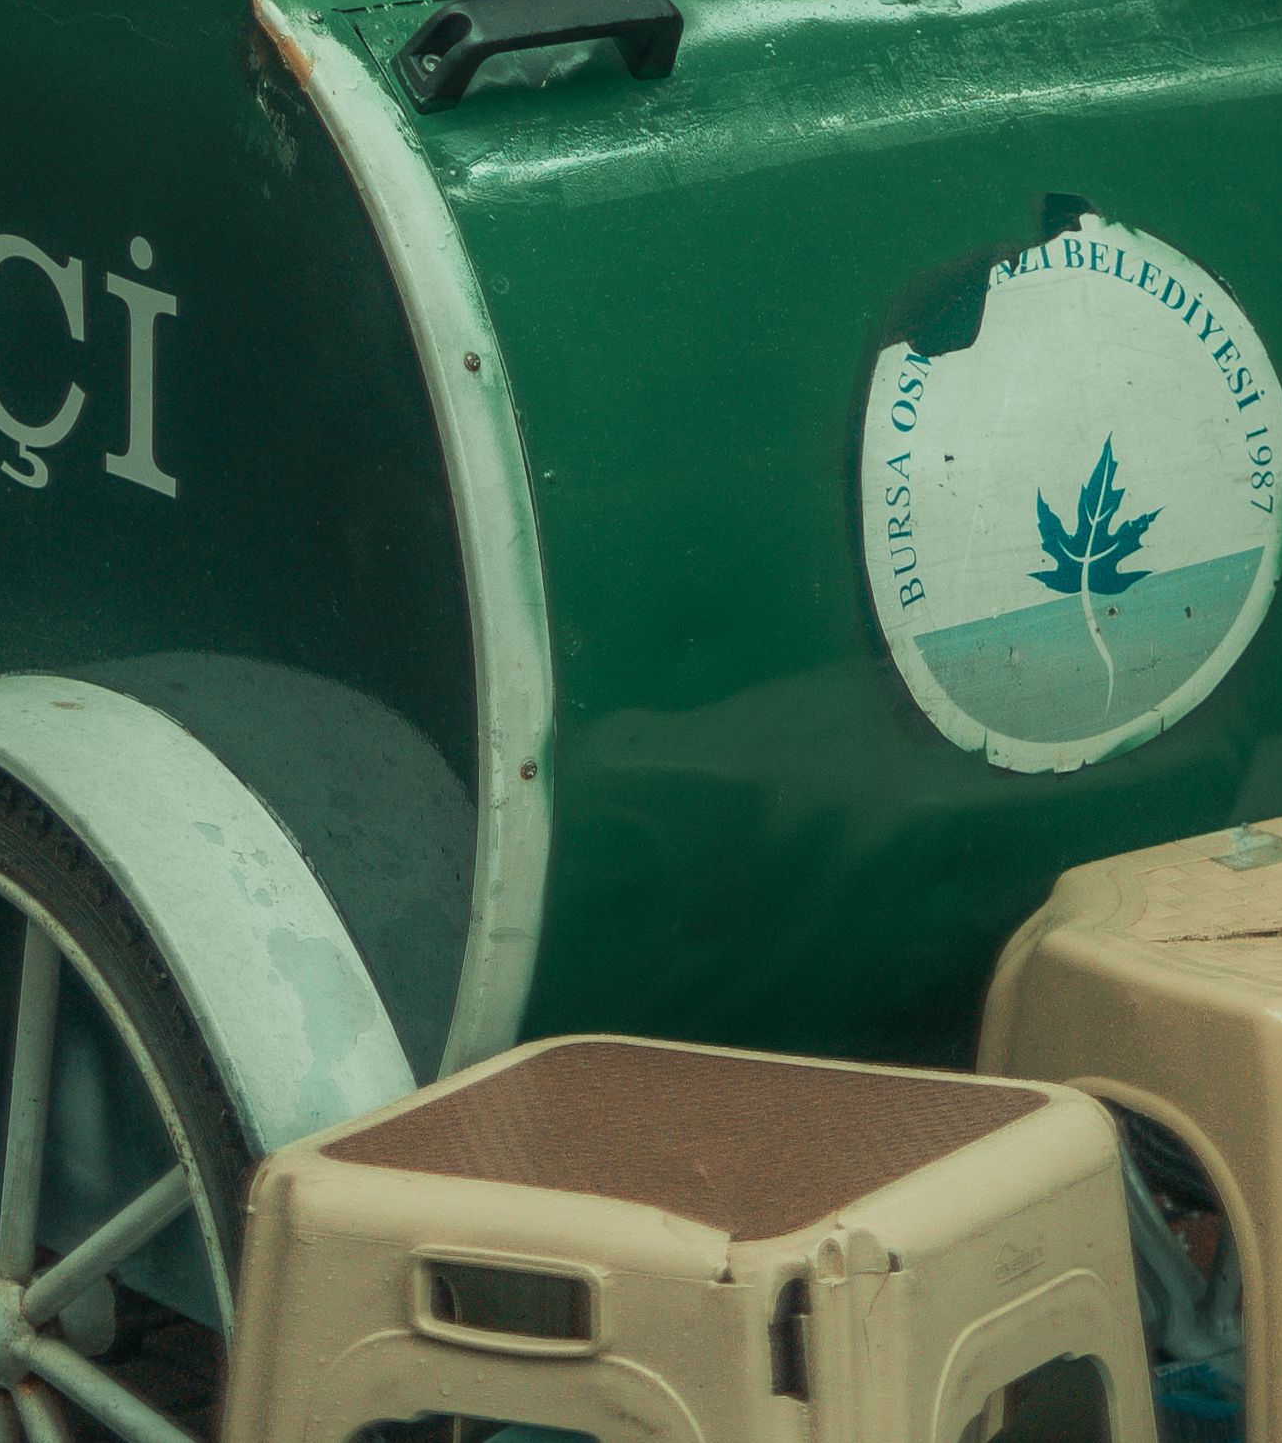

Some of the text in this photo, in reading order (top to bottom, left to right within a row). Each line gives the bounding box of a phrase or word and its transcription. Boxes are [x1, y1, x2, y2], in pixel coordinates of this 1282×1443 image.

[886, 451, 926, 611] BURSA
[1062, 238, 1266, 414] BELEDİYESİ
[1245, 425, 1275, 514] 1987
